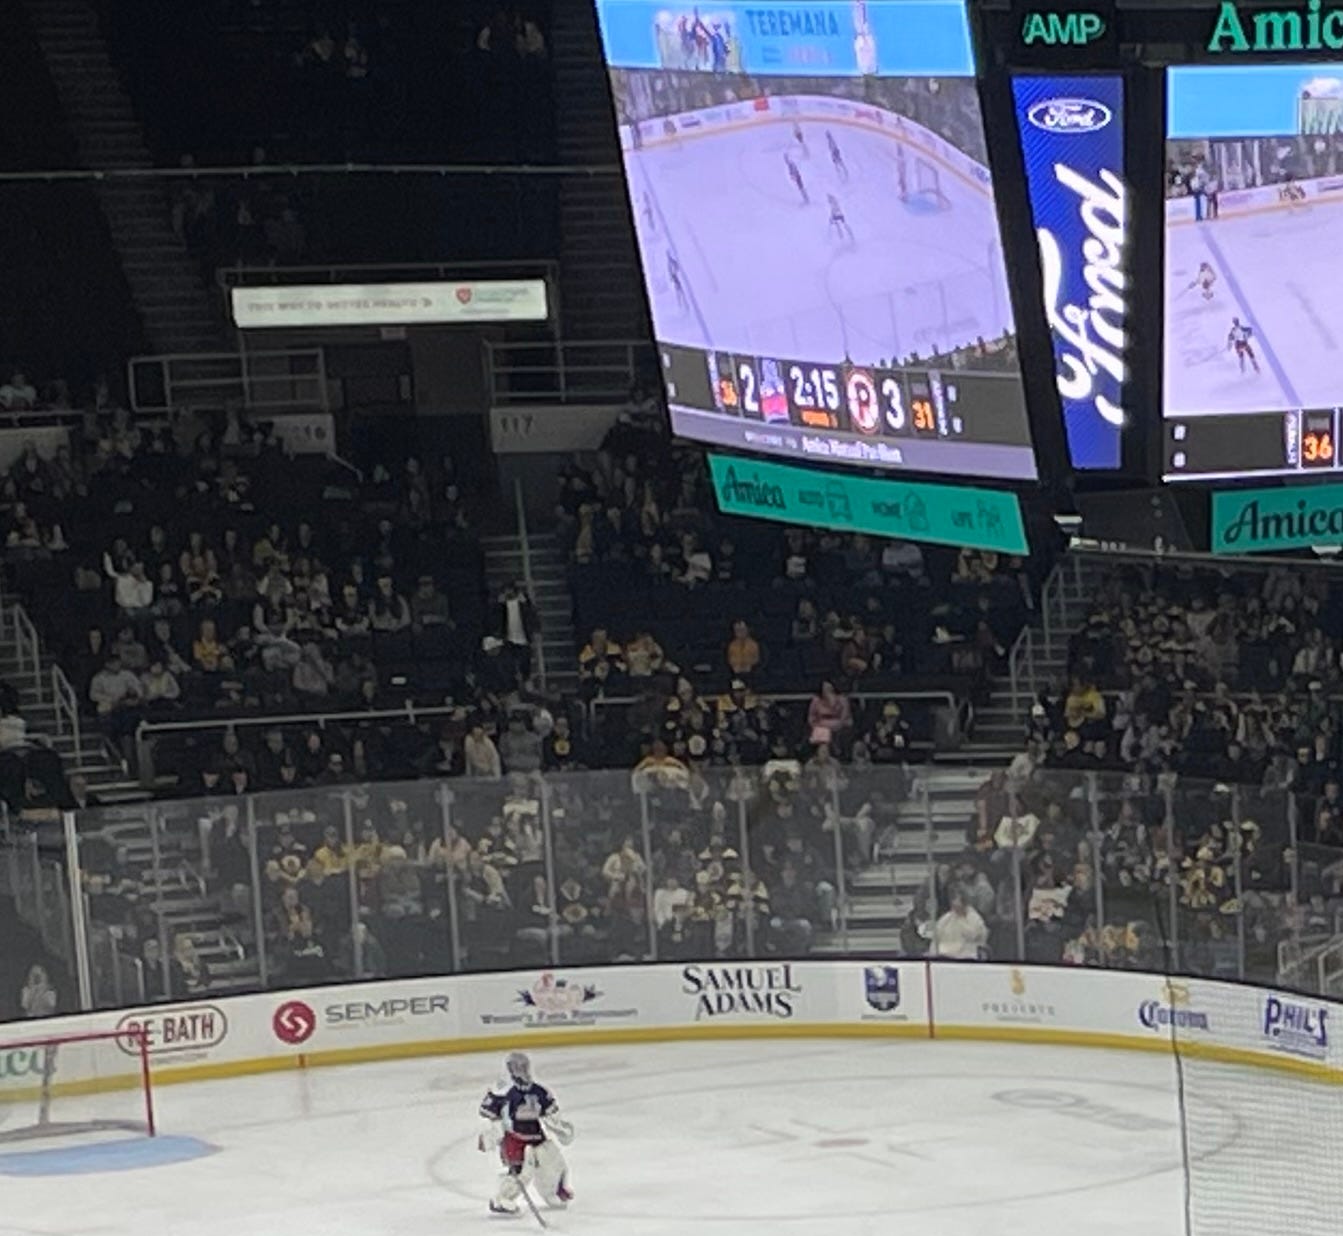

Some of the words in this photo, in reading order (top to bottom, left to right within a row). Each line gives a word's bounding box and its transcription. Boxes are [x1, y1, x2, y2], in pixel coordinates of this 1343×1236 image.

[746, 8, 841, 37] TEREMANA
[1023, 13, 1106, 46] AMP
[1037, 164, 1127, 426] Ford
[740, 364, 760, 412] 2
[790, 366, 840, 411] 2:15
[882, 378, 905, 430] 3
[913, 400, 935, 431] 31
[1304, 433, 1333, 461] 36
[721, 464, 787, 511] Amica
[681, 963, 803, 996] SAMUEL
[324, 994, 451, 1020] SEMPER
[694, 991, 794, 1022] ADAMS
[1137, 1000, 1210, 1031] Corona
[1263, 996, 1328, 1047] PHIL'S
